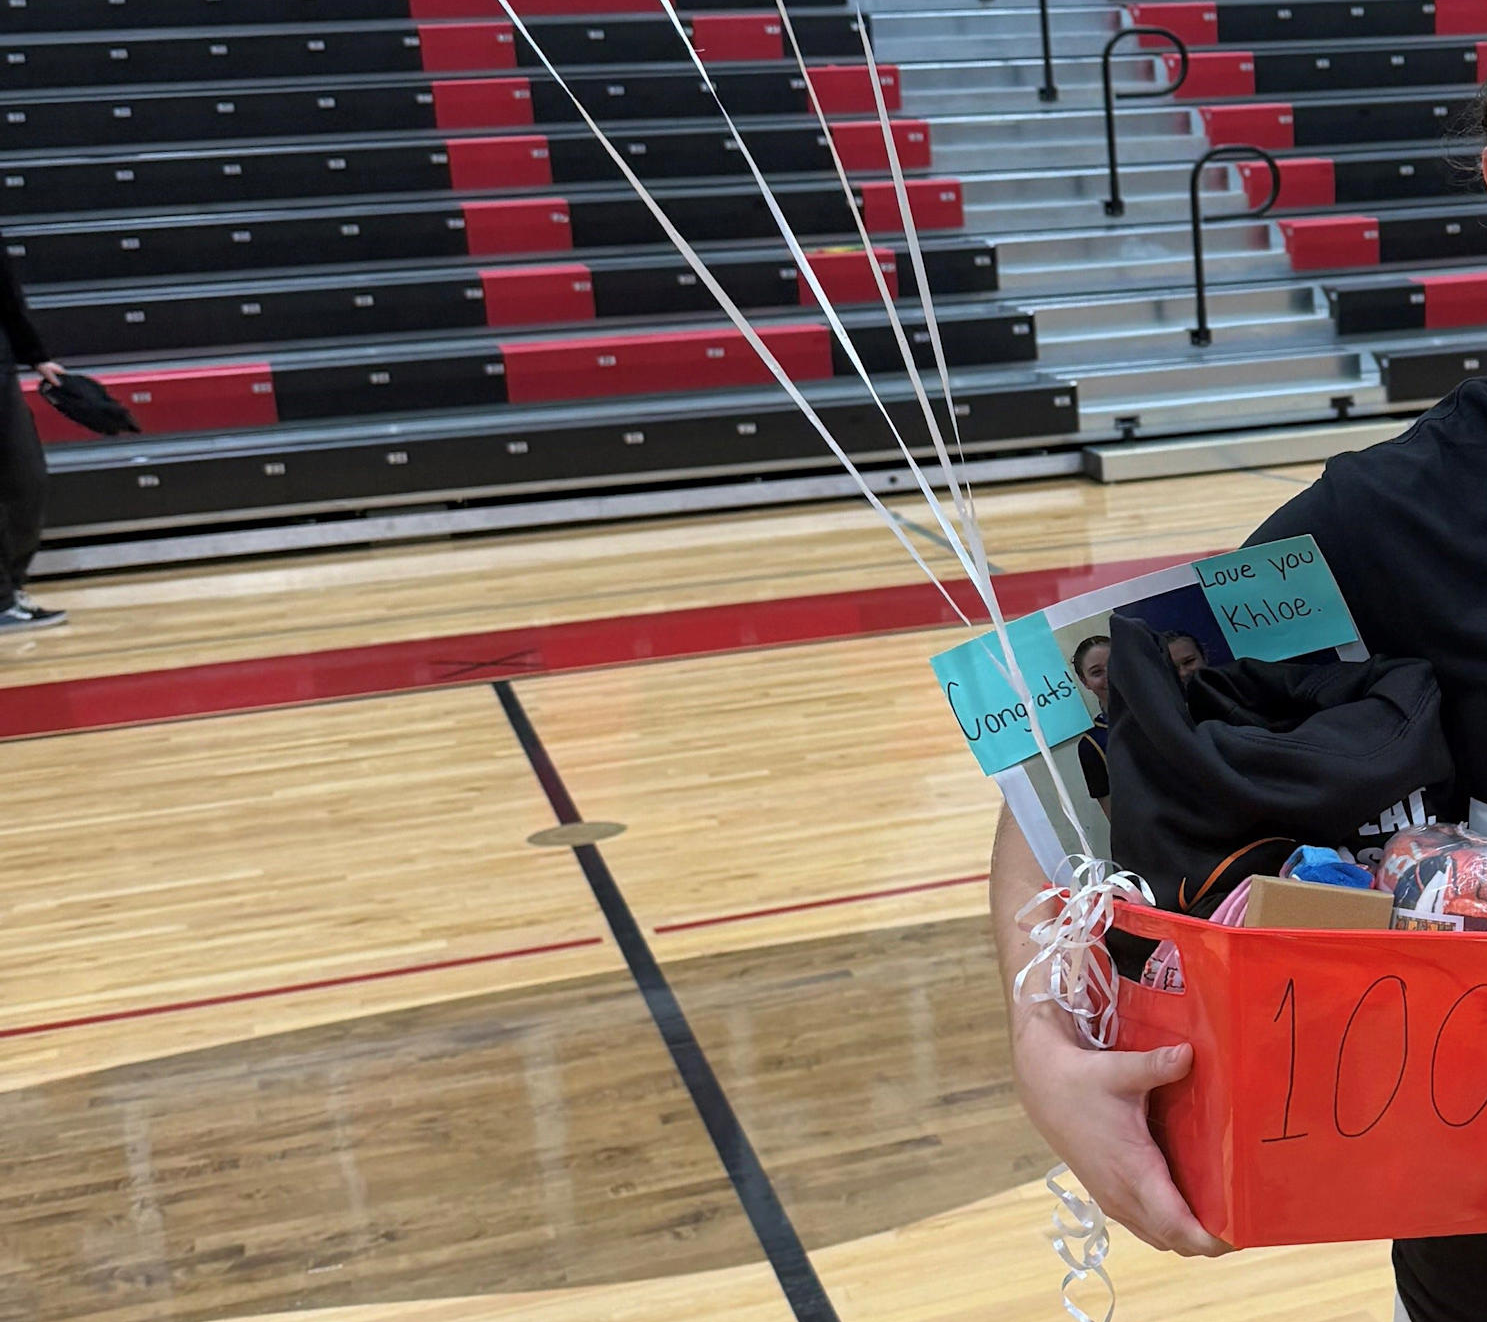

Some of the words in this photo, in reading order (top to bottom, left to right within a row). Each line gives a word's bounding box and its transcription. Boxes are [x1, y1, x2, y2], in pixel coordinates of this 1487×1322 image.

[1196, 562, 1256, 589] Love
[1268, 549, 1314, 583] you
[947, 671, 1078, 742] Congats!
